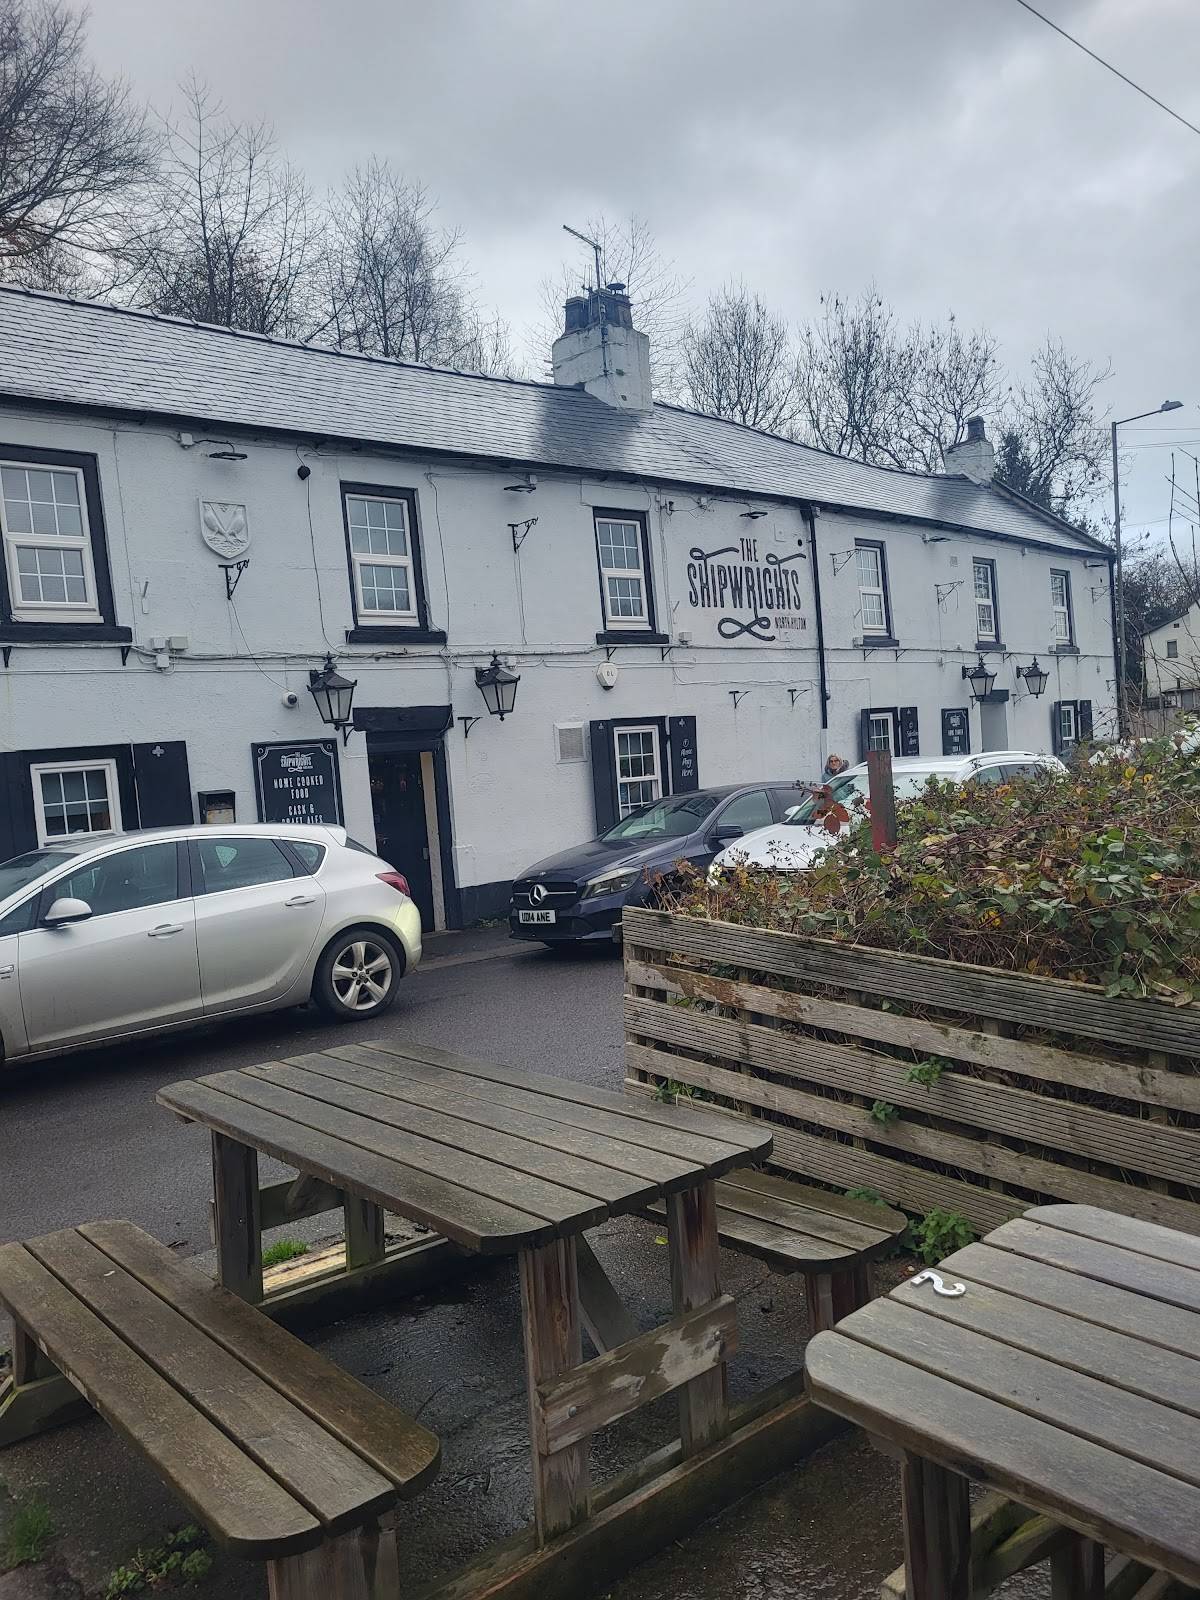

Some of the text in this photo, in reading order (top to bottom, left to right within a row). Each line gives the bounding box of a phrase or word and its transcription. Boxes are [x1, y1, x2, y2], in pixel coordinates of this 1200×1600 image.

[740, 538, 758, 562] THE
[686, 552, 803, 621] SHIPWRIGHTS
[273, 775, 324, 789] HOME COOKED
[291, 788, 309, 799] FOOD
[288, 804, 306, 816] CASK
[536, 911, 551, 922] ANE
